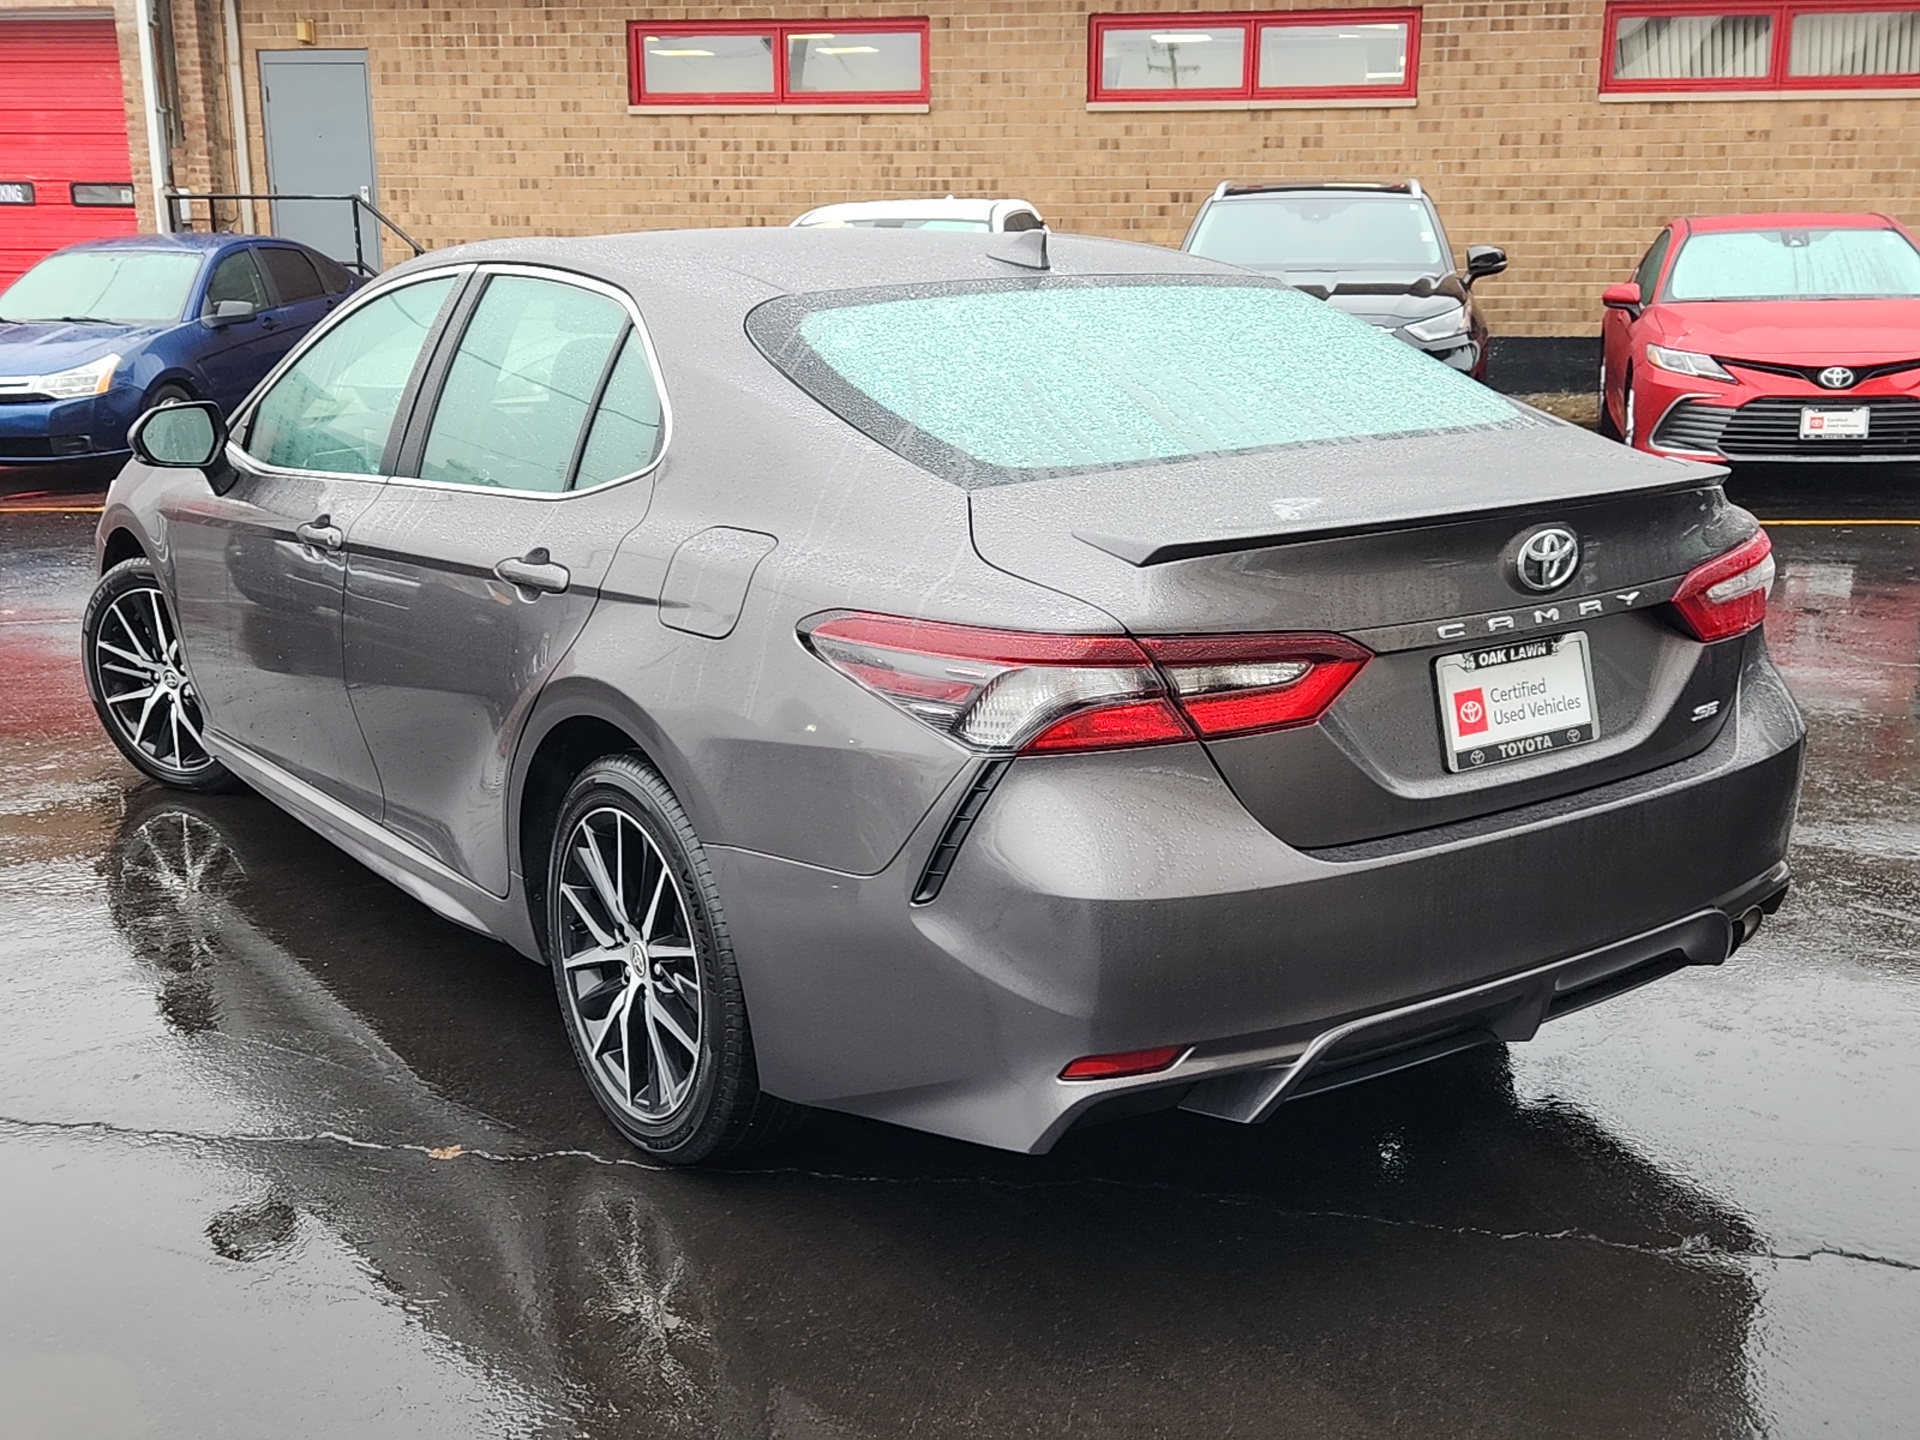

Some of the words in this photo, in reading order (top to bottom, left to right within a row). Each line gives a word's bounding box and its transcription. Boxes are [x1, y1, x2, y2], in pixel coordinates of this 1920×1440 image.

[1437, 591, 1640, 639] CAMRY
[1479, 649, 1507, 666] OAK
[1510, 642, 1547, 660] LAWN
[1490, 678, 1547, 702] Certified
[1494, 706, 1525, 725] Used
[1528, 695, 1581, 717] Vehicles
[1691, 700, 1720, 722] SE
[1498, 735, 1553, 758] TOYOTA
